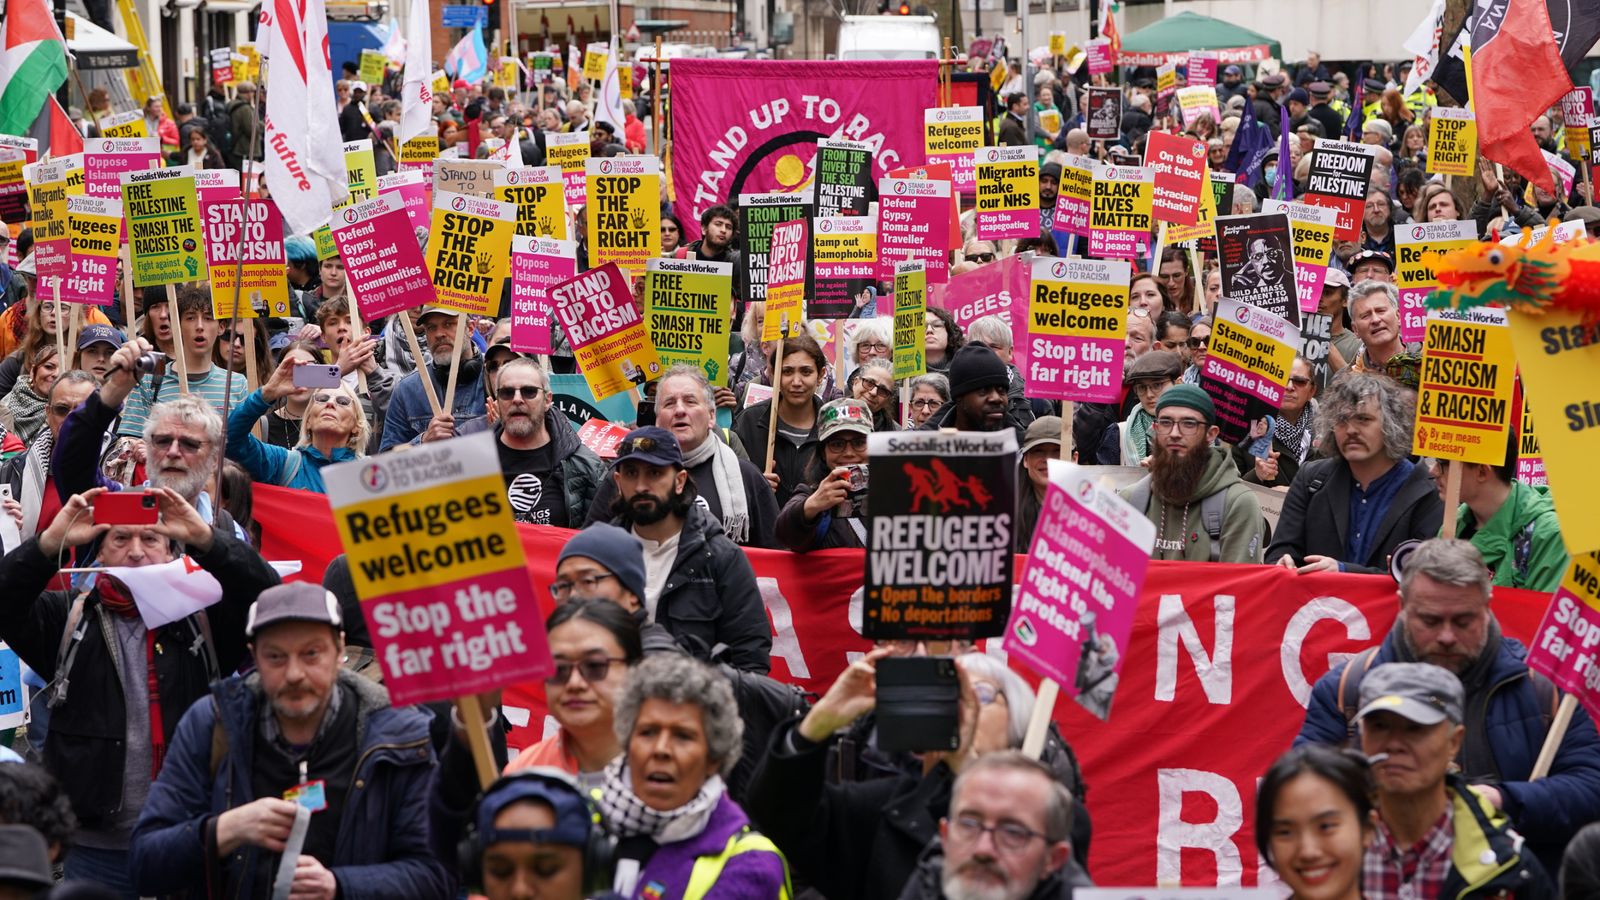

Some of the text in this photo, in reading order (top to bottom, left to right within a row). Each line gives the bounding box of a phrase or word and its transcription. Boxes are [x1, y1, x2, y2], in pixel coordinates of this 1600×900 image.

[750, 98, 790, 130] UP
[802, 95, 841, 124] TO
[928, 124, 981, 138] Refugees
[1437, 119, 1466, 130] STOP
[929, 138, 979, 150] welcome
[1437, 130, 1457, 141] THE
[1435, 141, 1455, 151] FAR
[88, 157, 128, 167] Oppose
[823, 149, 865, 163] FROM THE
[1159, 151, 1193, 167] On the
[1315, 153, 1366, 173] FREEDOM
[1434, 152, 1469, 163] RIGHT
[441, 167, 477, 181] STAND
[822, 161, 860, 173] RIVER TO
[1174, 164, 1201, 180] track
[1332, 170, 1341, 178] for
[821, 172, 855, 185] THE SEA
[978, 165, 1035, 187] Migrants
[127, 184, 152, 200] FREE
[596, 177, 641, 194] STOP
[820, 184, 865, 198] PALESTINE
[979, 181, 1013, 195] make
[1094, 183, 1140, 198] BLACK
[1309, 176, 1365, 197] PALESTINE
[33, 186, 65, 207] Migrants
[504, 186, 546, 204] STOP
[819, 195, 853, 209] WILL BE
[883, 198, 916, 208] Defend
[979, 193, 1031, 209] our NHS
[130, 196, 186, 216] PALESTINE
[597, 196, 629, 212] THE
[1059, 199, 1078, 212] Stop
[1094, 197, 1134, 212] LIVES
[34, 208, 53, 222] make
[207, 203, 268, 223] STAND
[598, 213, 628, 230] FAR
[748, 207, 780, 222] FROM
[980, 214, 1011, 224] Stop the
[1057, 212, 1072, 224] far
[1093, 212, 1149, 228] MATTER
[48, 221, 64, 235] NHS
[133, 218, 195, 238] SMASH THE
[210, 222, 265, 242] UP TO
[337, 222, 375, 243] Defend
[443, 213, 494, 237] STOP
[883, 222, 929, 233] Roma and
[980, 221, 1029, 232] scapegoating
[441, 231, 478, 254] THE
[598, 231, 650, 248] RIGHT
[773, 224, 803, 246] STAND
[882, 234, 924, 244] Traveller
[1092, 231, 1135, 243] No justice
[135, 236, 179, 254] RACISTS
[212, 241, 281, 261] RACISM
[1092, 240, 1131, 252] No peace
[347, 243, 398, 267] Roma and
[436, 250, 473, 272] FAR
[516, 256, 549, 269] Oppose
[82, 260, 107, 275] the
[155, 258, 180, 271] against
[351, 259, 397, 280] Traveller
[768, 260, 804, 284] RACISM
[834, 265, 873, 275] the hate
[1069, 263, 1093, 271] STAND
[67, 276, 104, 293] right
[357, 265, 422, 293] communities
[433, 268, 493, 294] RIGHT
[652, 274, 683, 291] FREE
[897, 276, 908, 290] FREE
[1080, 272, 1110, 281] RACISM
[361, 276, 428, 306] Stop the hate
[515, 284, 546, 298] Defend
[552, 271, 611, 309] STAND
[1261, 284, 1284, 292] MASS
[652, 291, 718, 310] PALESTINE
[896, 290, 922, 306] PALESTINE
[1035, 284, 1124, 310] Refugees
[1232, 292, 1272, 302] OVEMENT
[1257, 296, 1288, 306] RACISM
[515, 300, 537, 313] right
[559, 291, 614, 326] UP TO
[514, 315, 547, 329] protest
[568, 302, 638, 346] RACISM
[651, 315, 723, 334] SMASH THE
[1035, 309, 1118, 331] welcome
[1216, 323, 1275, 357] Stamp out
[1259, 324, 1285, 339] RACISM
[1427, 324, 1486, 354] SMASH
[651, 332, 703, 350] RACISTS
[1032, 338, 1113, 364] Stop the
[1212, 339, 1285, 380] Islamophobia
[1030, 363, 1110, 390] far right
[1207, 360, 1280, 402] Stop the hate
[1424, 357, 1498, 390] FASCISM
[1420, 393, 1506, 425] & RACISM
[1429, 427, 1481, 445] By any means
[1429, 442, 1466, 456] necessary
[346, 491, 502, 544] Refugees
[1050, 491, 1106, 544] Oppose
[872, 514, 1010, 550] REFUGEES
[359, 533, 506, 582] welcome
[1042, 516, 1136, 598] Islamophobia
[870, 550, 1006, 586] WELCOME
[1035, 538, 1115, 610] Defend the
[882, 586, 1001, 602] Open the borders
[1027, 566, 1088, 616] right to
[373, 584, 517, 637] Stop the
[880, 606, 992, 624] No deportations
[1019, 591, 1081, 642] protest
[385, 621, 527, 679] far right
[1541, 625, 1574, 662] far
